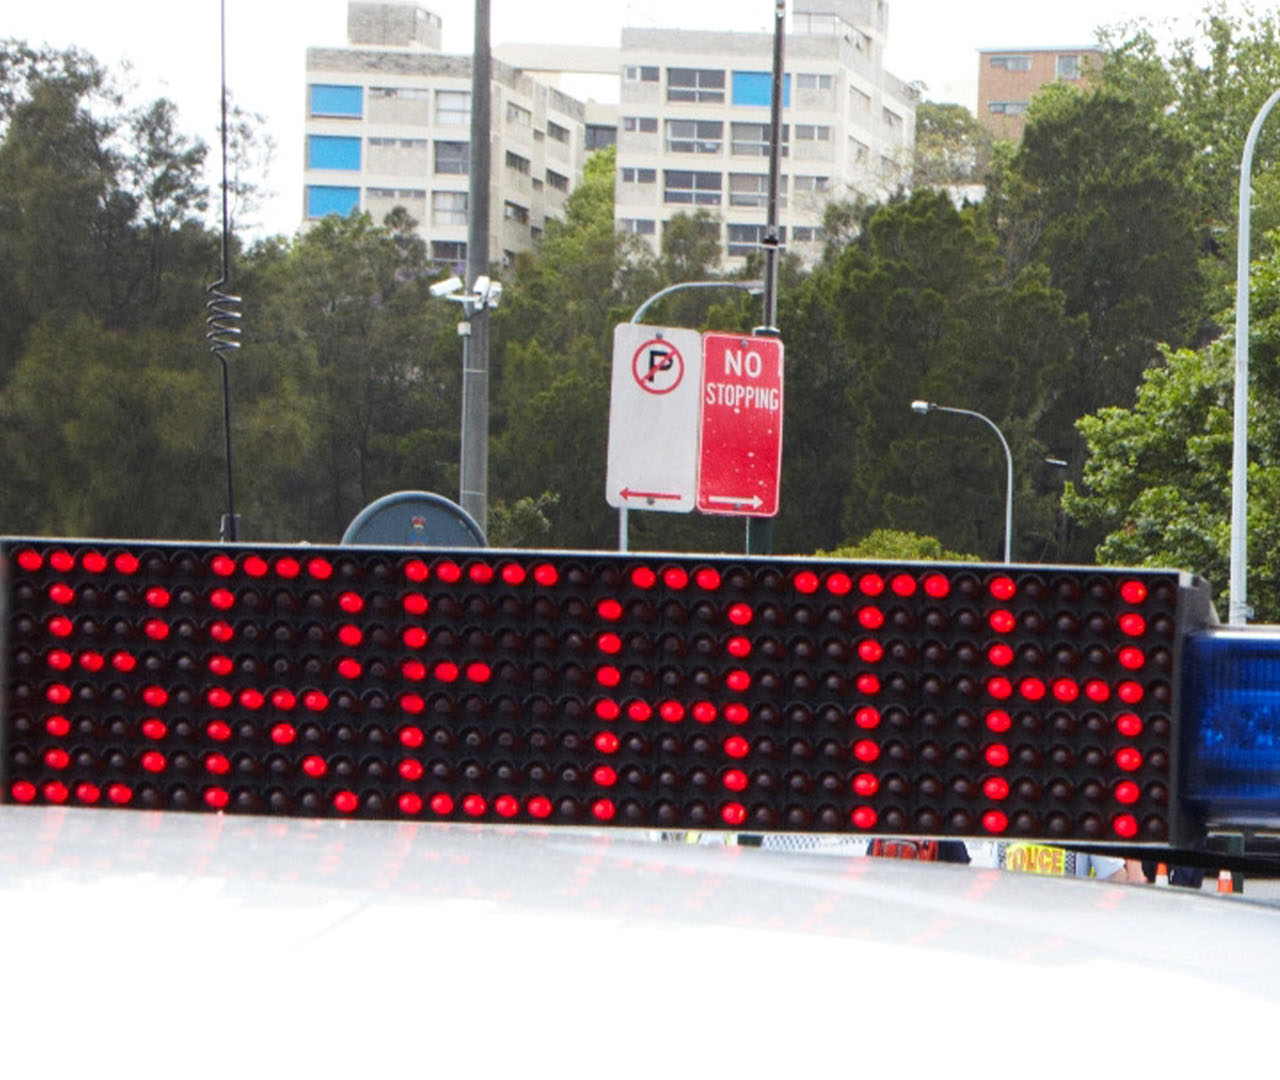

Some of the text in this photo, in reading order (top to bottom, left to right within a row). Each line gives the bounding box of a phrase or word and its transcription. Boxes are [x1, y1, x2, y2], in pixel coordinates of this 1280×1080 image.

[724, 350, 763, 378] NO
[705, 382, 779, 411] STOPPING
[10, 547, 1147, 840] BREATH
